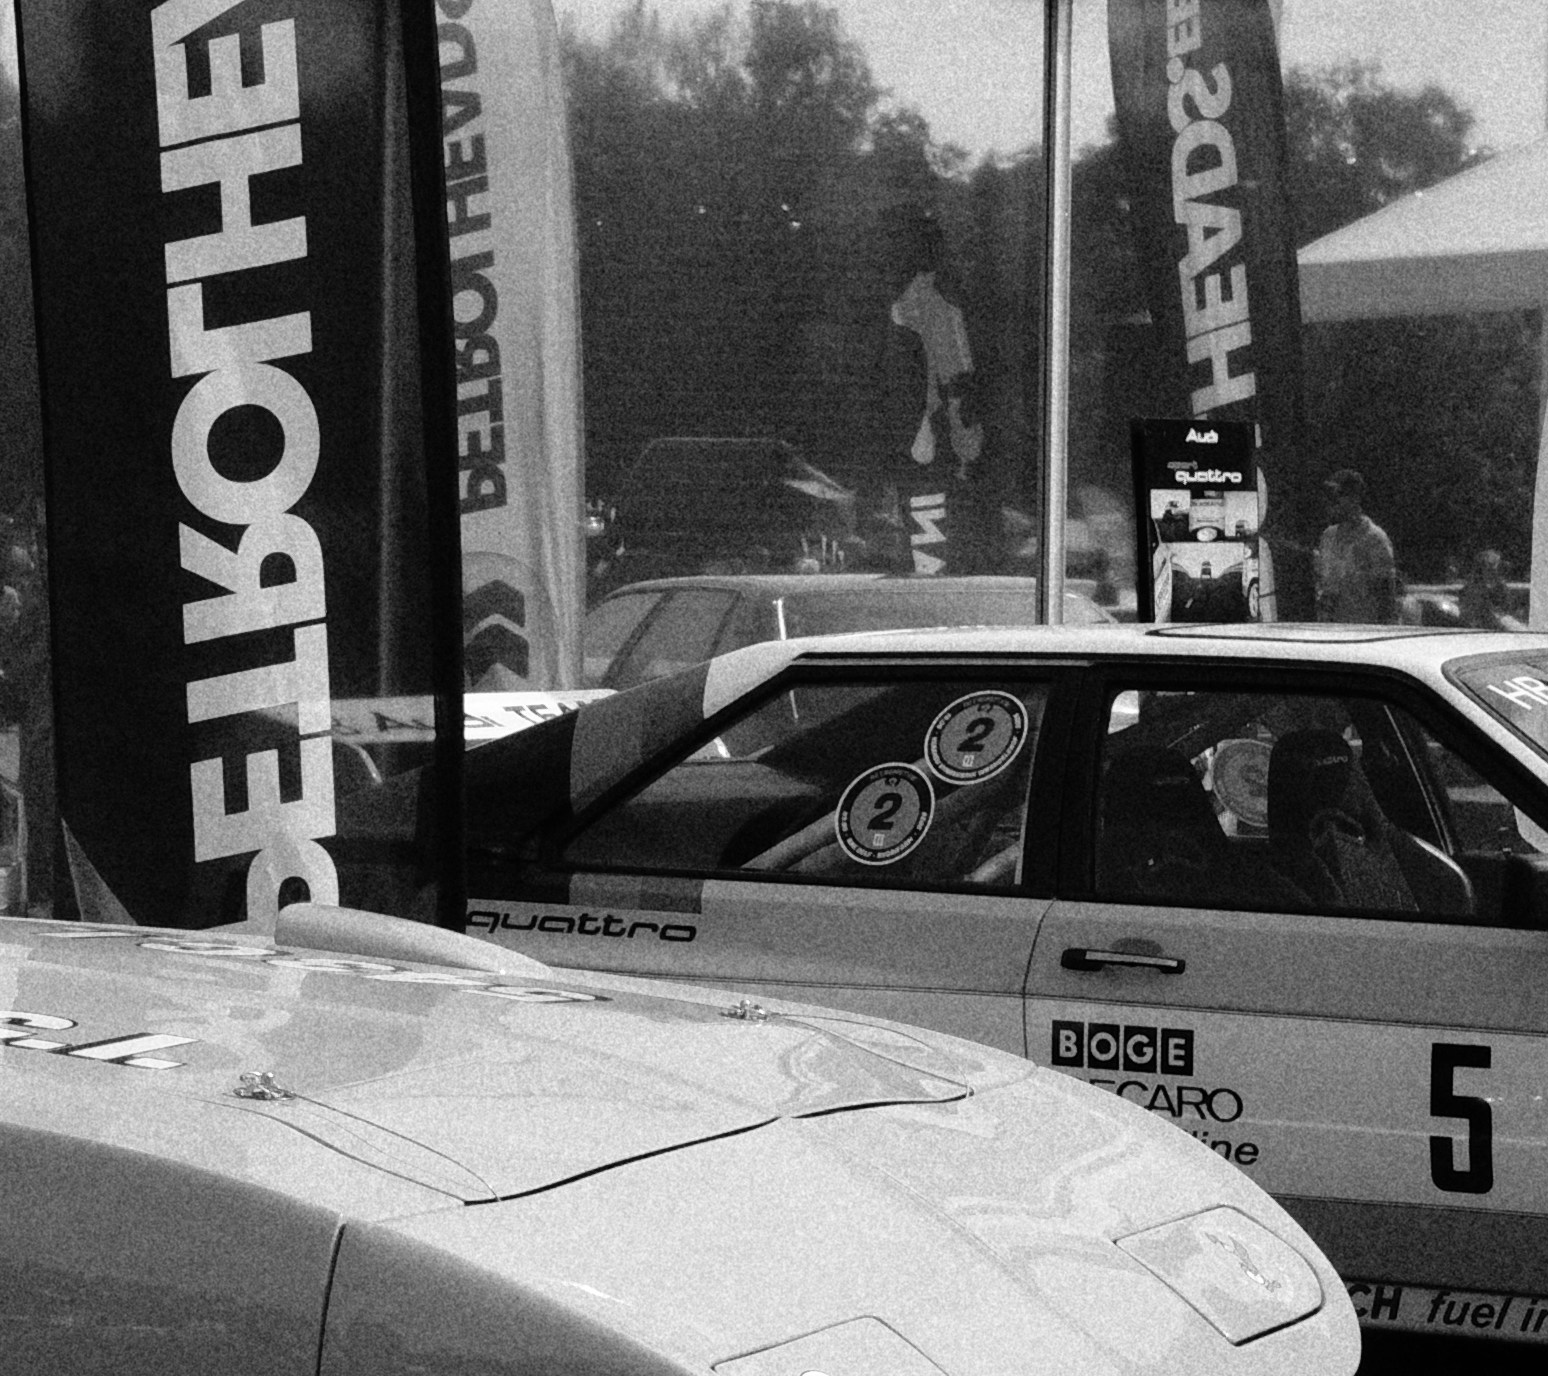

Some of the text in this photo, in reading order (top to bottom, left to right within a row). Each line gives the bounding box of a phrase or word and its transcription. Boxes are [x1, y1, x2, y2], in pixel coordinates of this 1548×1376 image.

[1175, 469, 1242, 485] quattro
[957, 717, 995, 752] 2
[867, 793, 903, 830] 2
[467, 908, 697, 942] quattro
[1056, 1026, 1189, 1069] BOGE
[1429, 1042, 1494, 1195] 5
[1426, 1291, 1516, 1330] fuel
